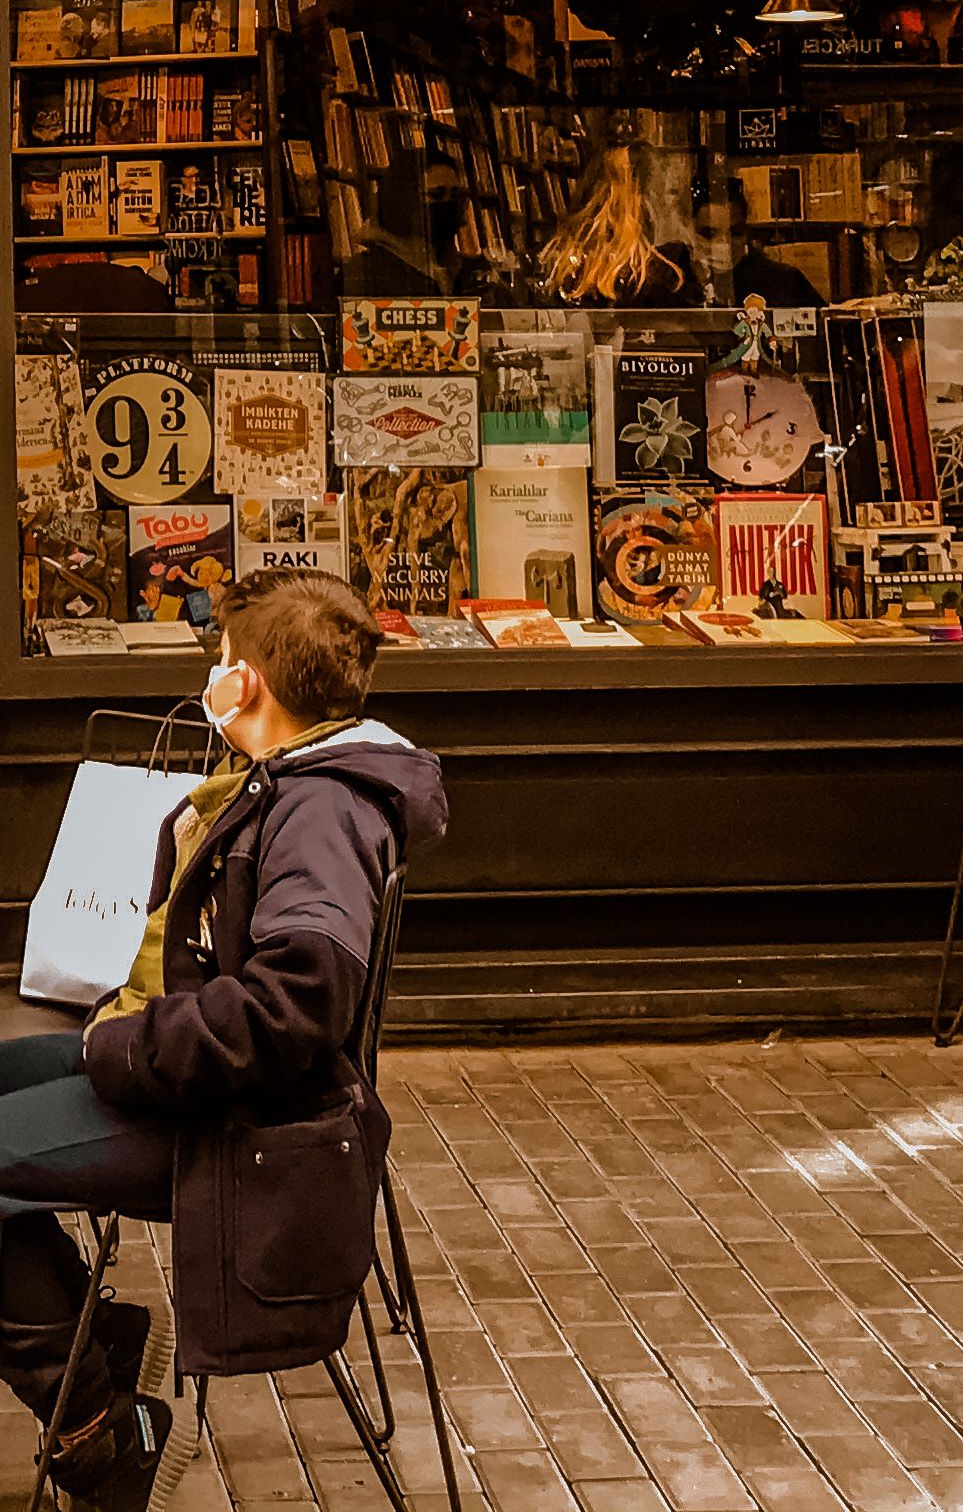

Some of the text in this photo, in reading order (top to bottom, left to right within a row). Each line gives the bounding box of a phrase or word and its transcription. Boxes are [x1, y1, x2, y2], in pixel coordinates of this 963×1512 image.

[381, 310, 438, 325] CHESS
[96, 356, 194, 384] PLATFORM
[246, 418, 294, 430] KADEHE
[373, 416, 436, 431] Collection
[95, 395, 149, 479] 9
[525, 510, 574, 523] Carians
[136, 511, 209, 540] Tabu
[263, 551, 317, 567] RAKI
[388, 552, 432, 567] STEVE
[667, 550, 710, 562] DÜNYA
[729, 525, 817, 596] NUTUK
[669, 563, 709, 572] SANAT
[373, 569, 449, 584] McCURRY
[377, 587, 447, 602] ANIMALS
